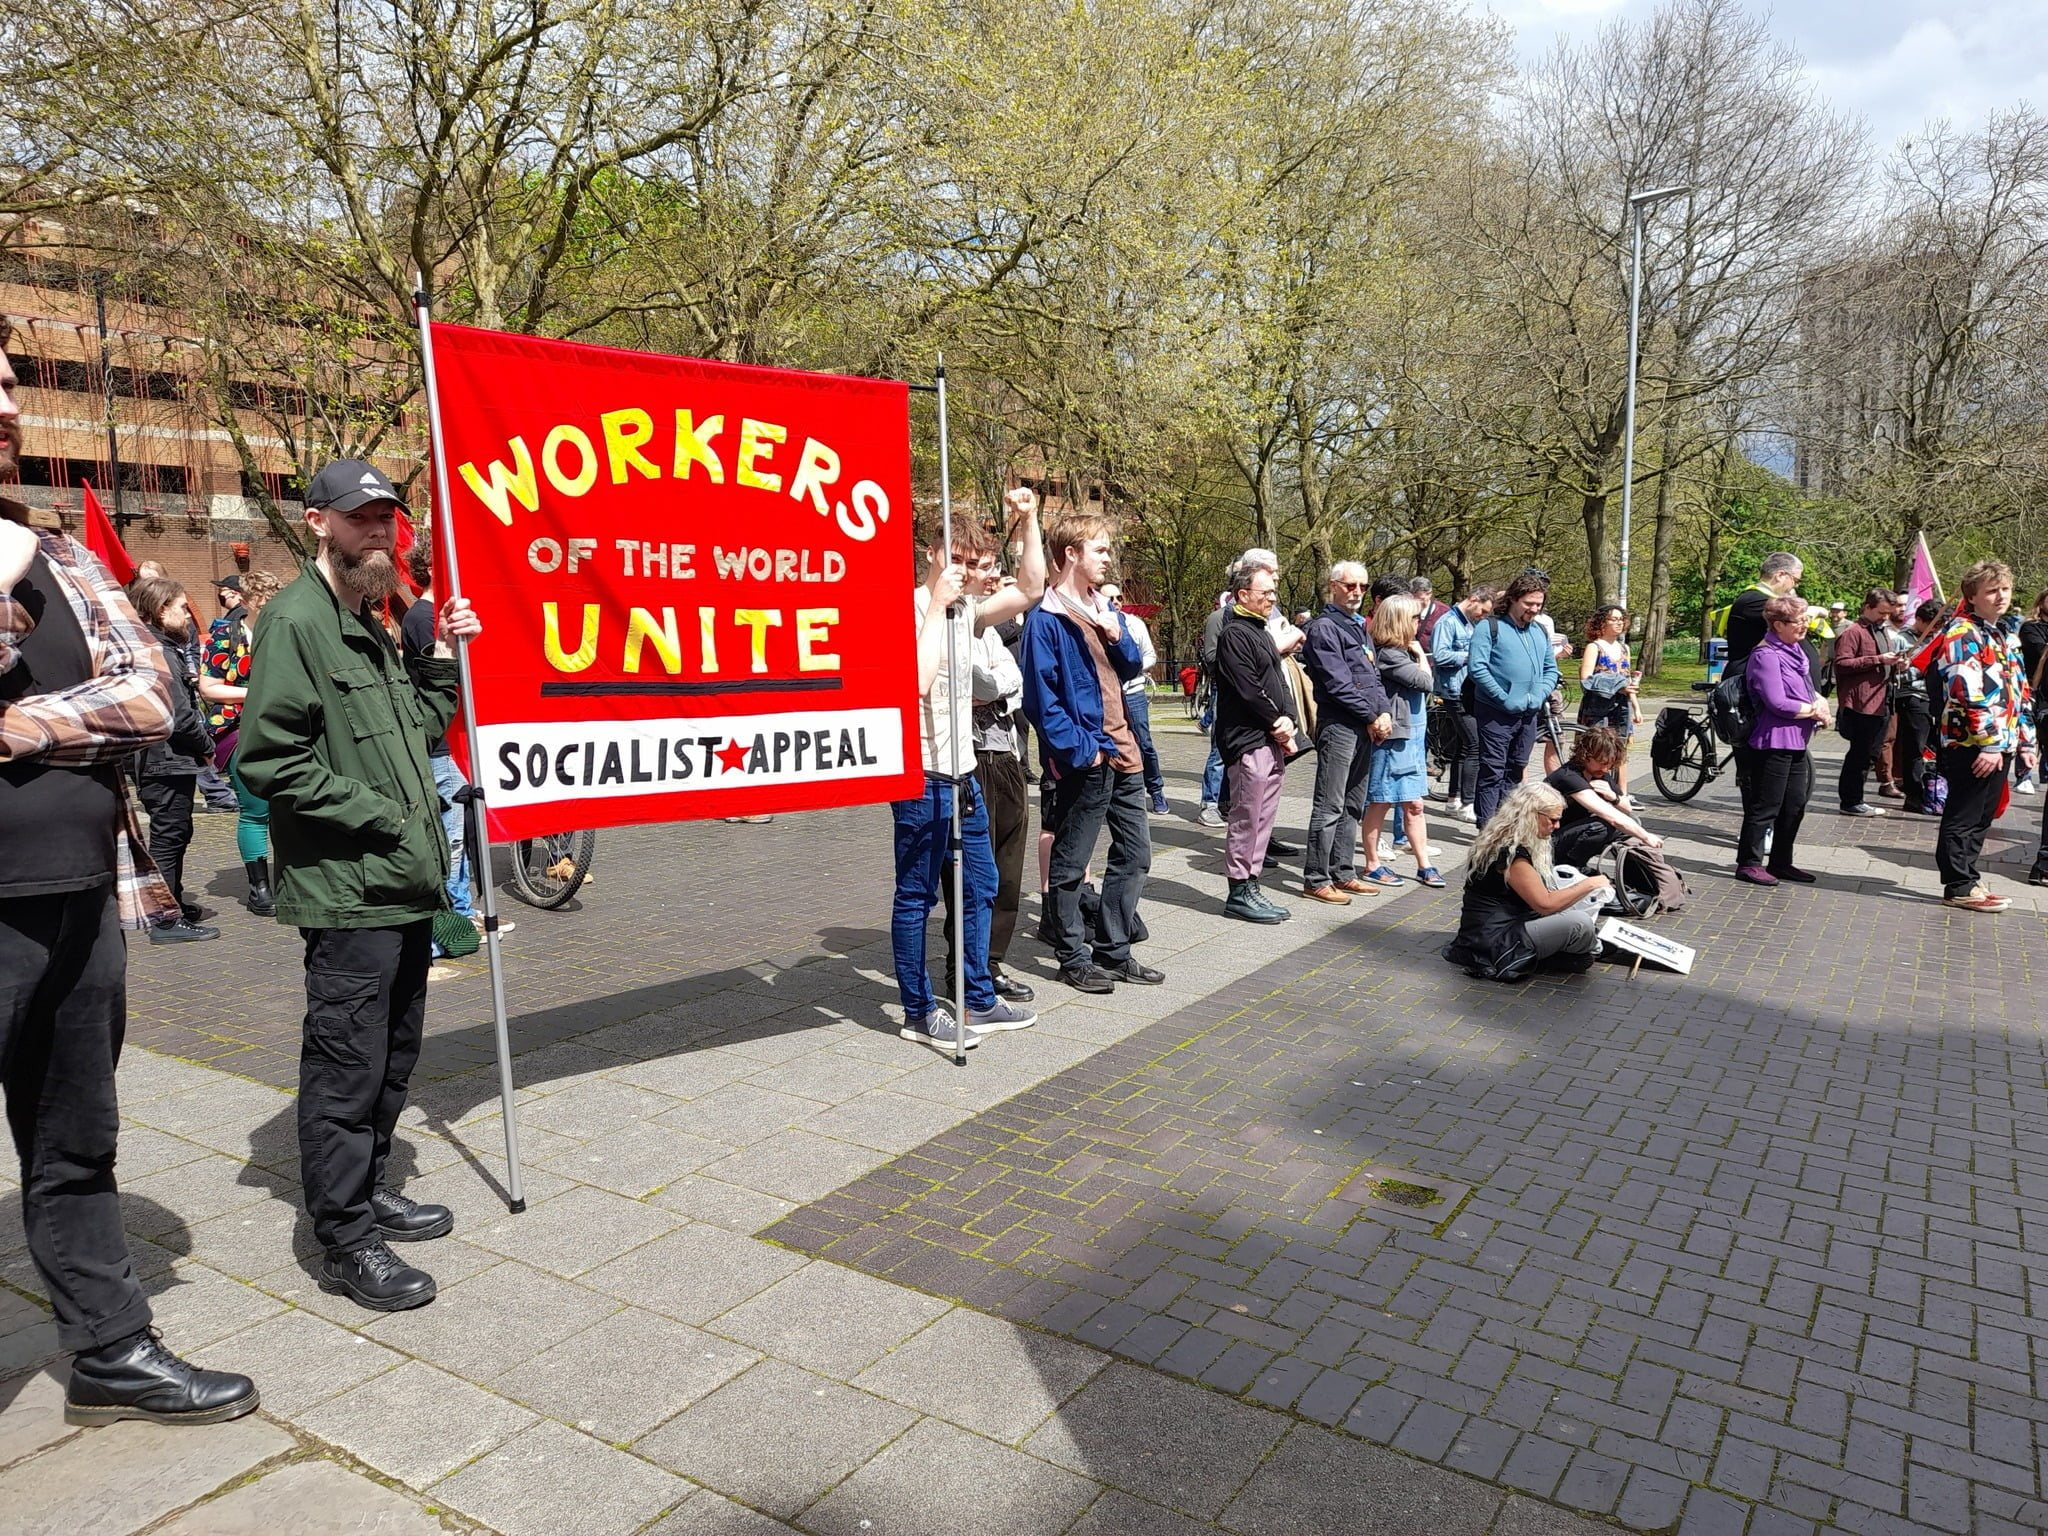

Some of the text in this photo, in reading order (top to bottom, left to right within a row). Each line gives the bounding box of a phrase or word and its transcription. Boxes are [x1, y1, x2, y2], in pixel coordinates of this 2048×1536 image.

[458, 408, 889, 541] WORKERS
[528, 537, 846, 582] OF THE WORLD
[543, 602, 840, 674] UNITE
[499, 727, 877, 790] SOCIALIST APPEAL
